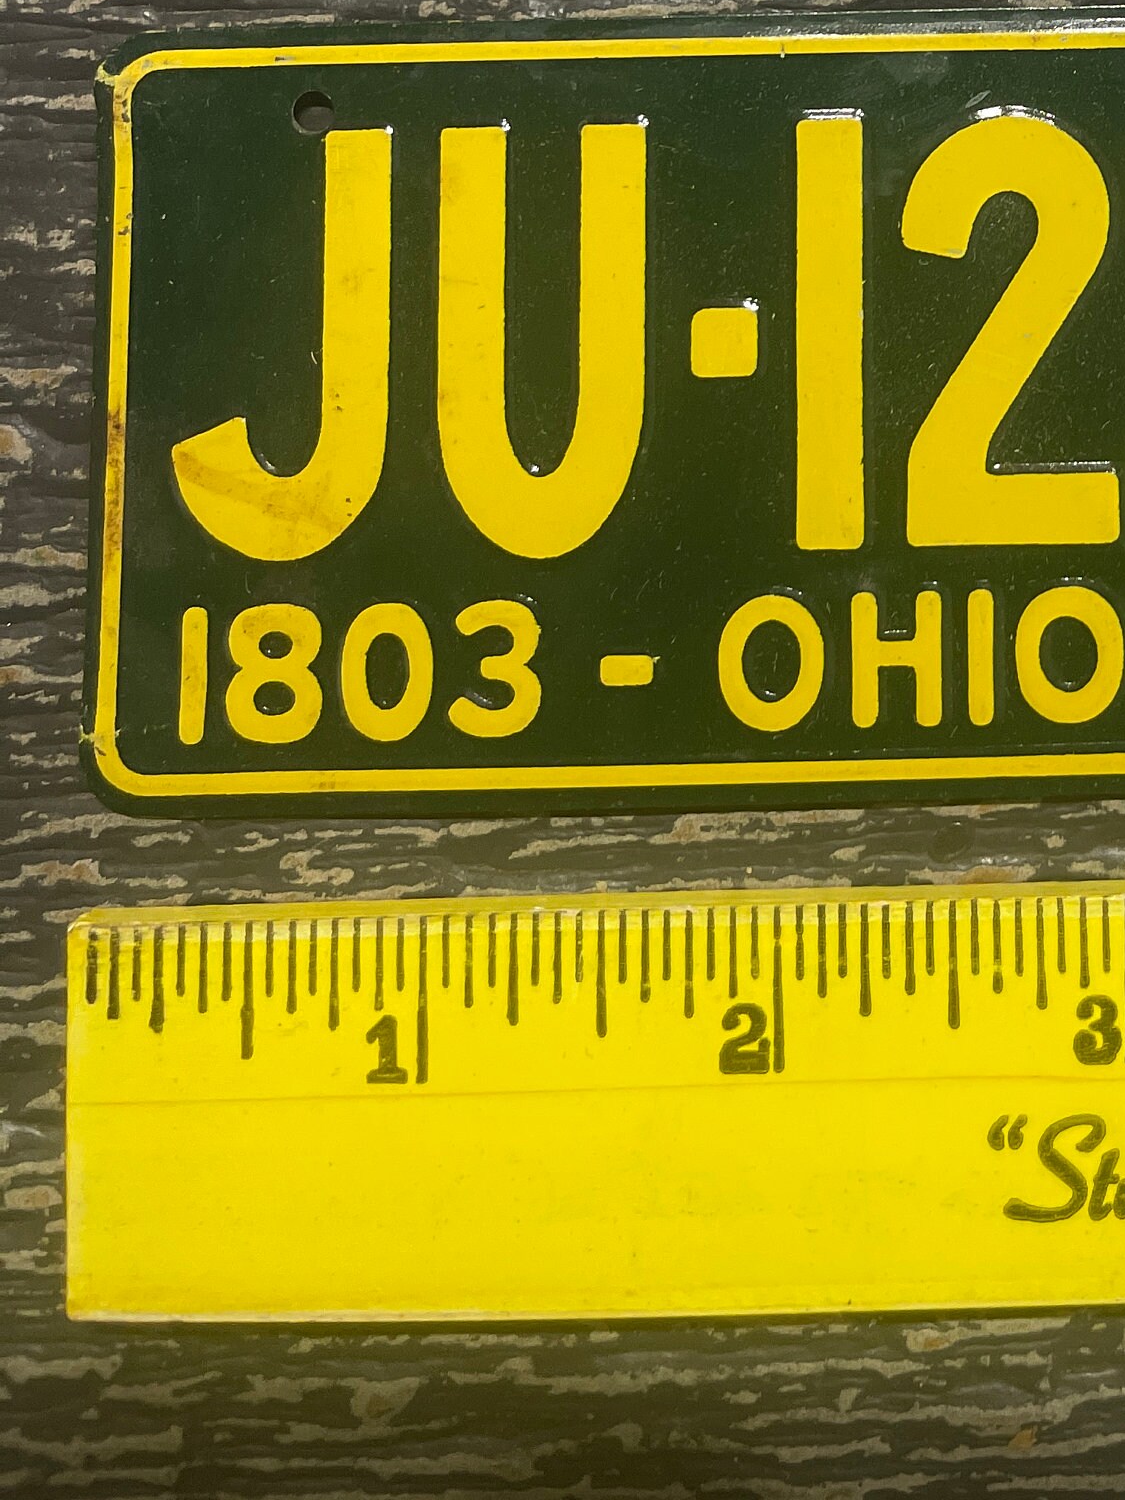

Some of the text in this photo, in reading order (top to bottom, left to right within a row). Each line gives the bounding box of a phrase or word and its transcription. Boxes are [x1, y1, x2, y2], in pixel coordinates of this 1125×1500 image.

[180, 599, 542, 745] 1803
[717, 585, 1125, 732] OHIO
[365, 1015, 409, 1085] 1
[718, 1003, 771, 1075] 2
[1073, 995, 1124, 1065] 3
